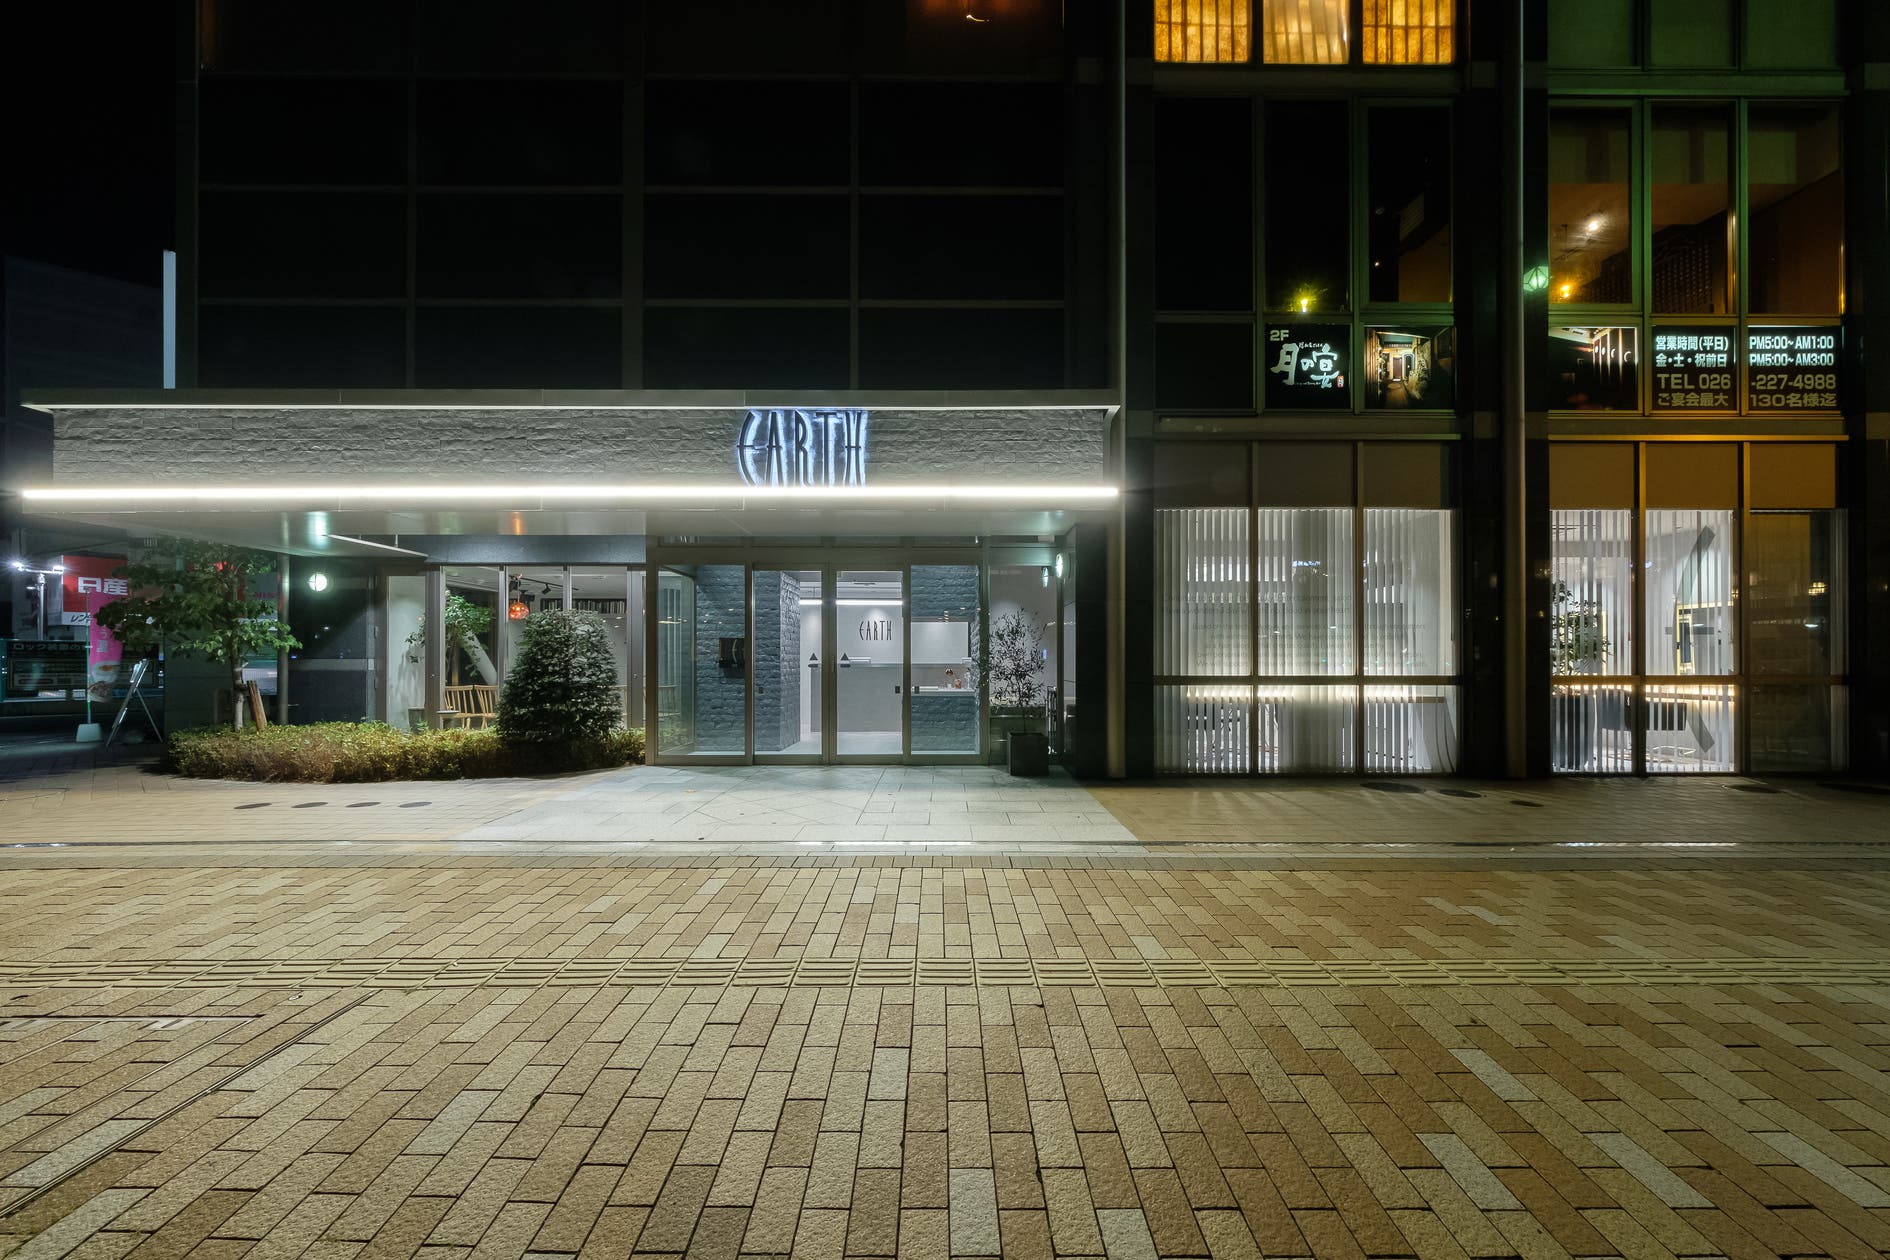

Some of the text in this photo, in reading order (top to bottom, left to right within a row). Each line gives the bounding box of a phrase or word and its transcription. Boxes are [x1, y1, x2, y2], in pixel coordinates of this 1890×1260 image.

[1269, 329, 1290, 342] 2F
[1655, 335, 1729, 351] 営業時間(平日)
[1657, 373, 1837, 390] TEL 026 -227-4988
[1658, 392, 1837, 407] ご宴会最大 130名様迄
[737, 410, 864, 487] EARTH
[77, 576, 128, 596] 日産
[859, 619, 893, 642] EARTH
